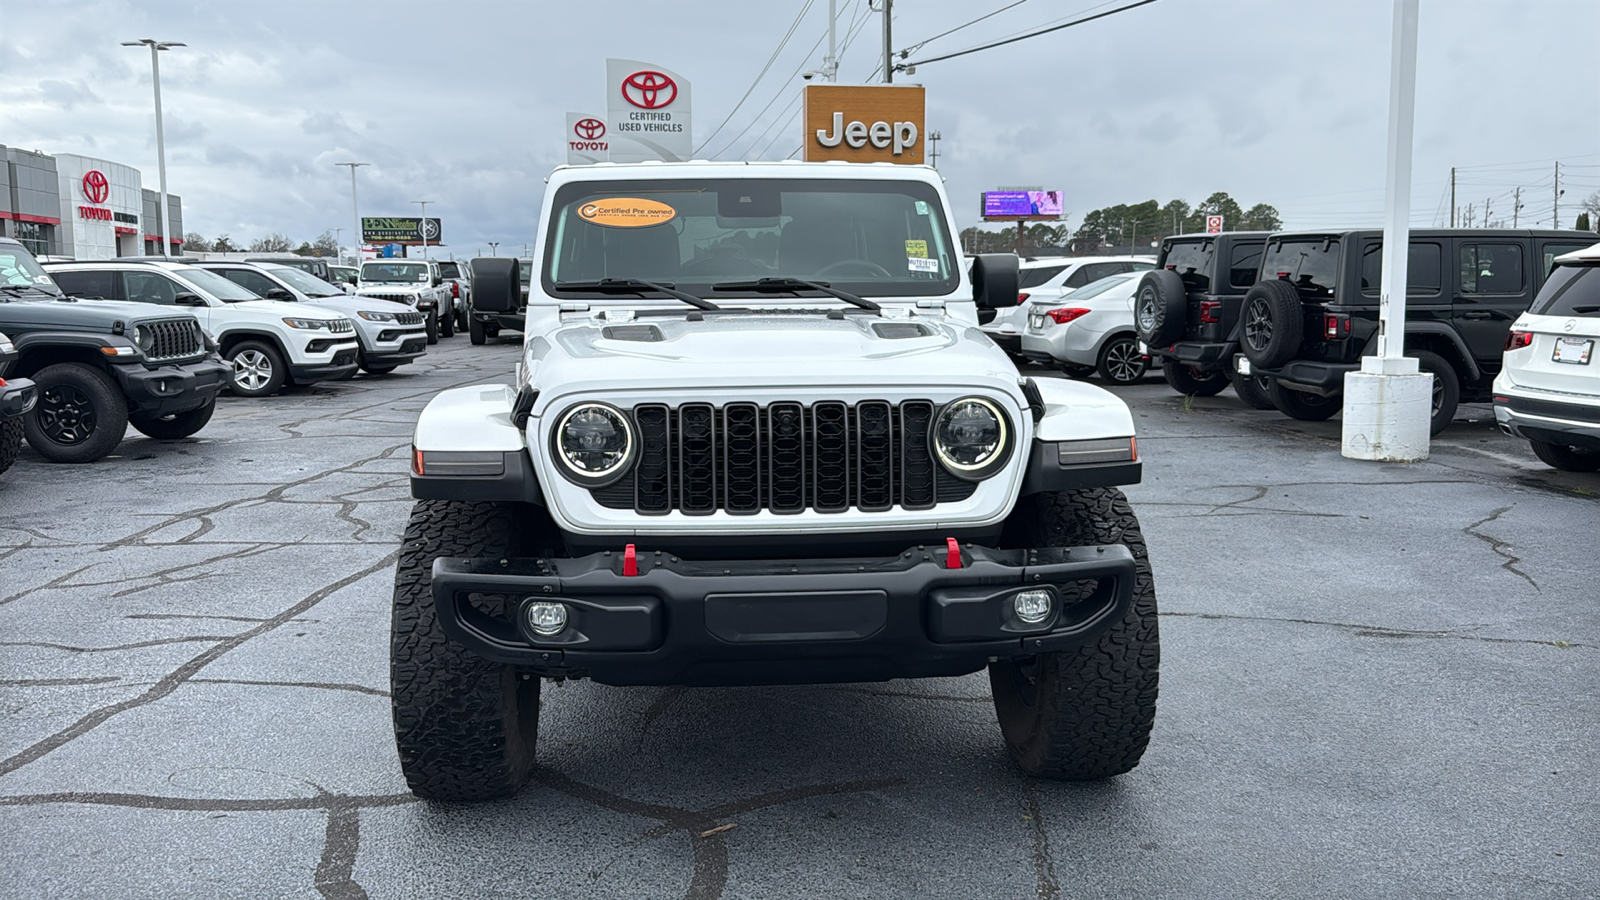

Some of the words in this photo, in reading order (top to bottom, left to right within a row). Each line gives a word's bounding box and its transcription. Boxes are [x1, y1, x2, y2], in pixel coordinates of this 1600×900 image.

[629, 112, 671, 121] CERTIFIED
[618, 123, 641, 132] USED
[643, 123, 683, 133] VEHICLES
[816, 111, 918, 155] Jeep
[79, 206, 113, 221] TOYOTA
[363, 218, 396, 228] PENN
[1380, 294, 1389, 307] A4
